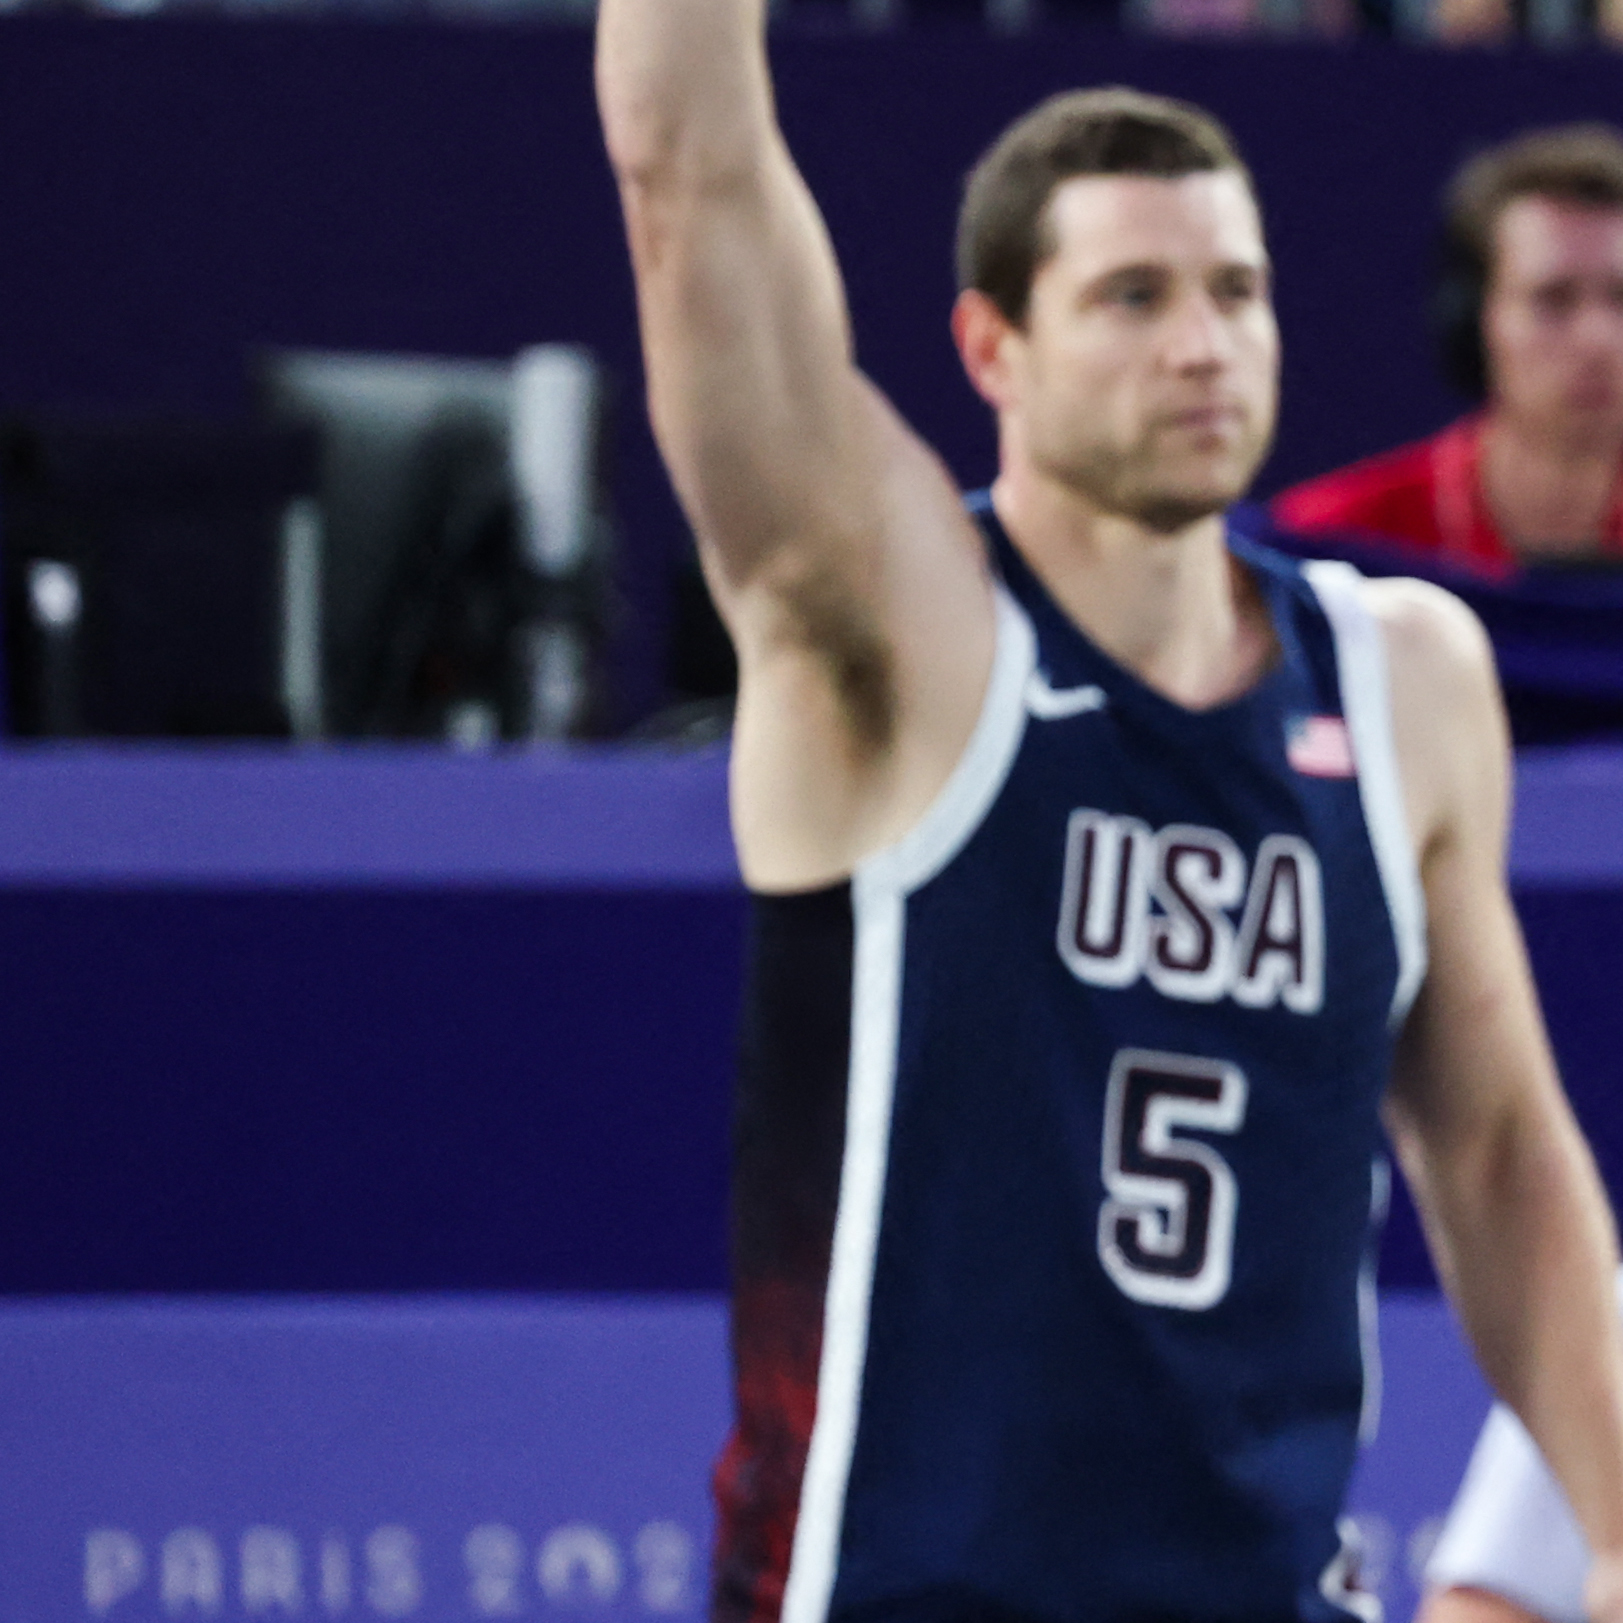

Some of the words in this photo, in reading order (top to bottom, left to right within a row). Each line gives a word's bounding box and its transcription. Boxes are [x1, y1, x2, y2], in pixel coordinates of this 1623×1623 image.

[1056, 806, 1326, 1016] USA
[1097, 1047, 1249, 1312] 5
[84, 1524, 422, 1616] PARIS
[462, 1519, 692, 1616] 202
